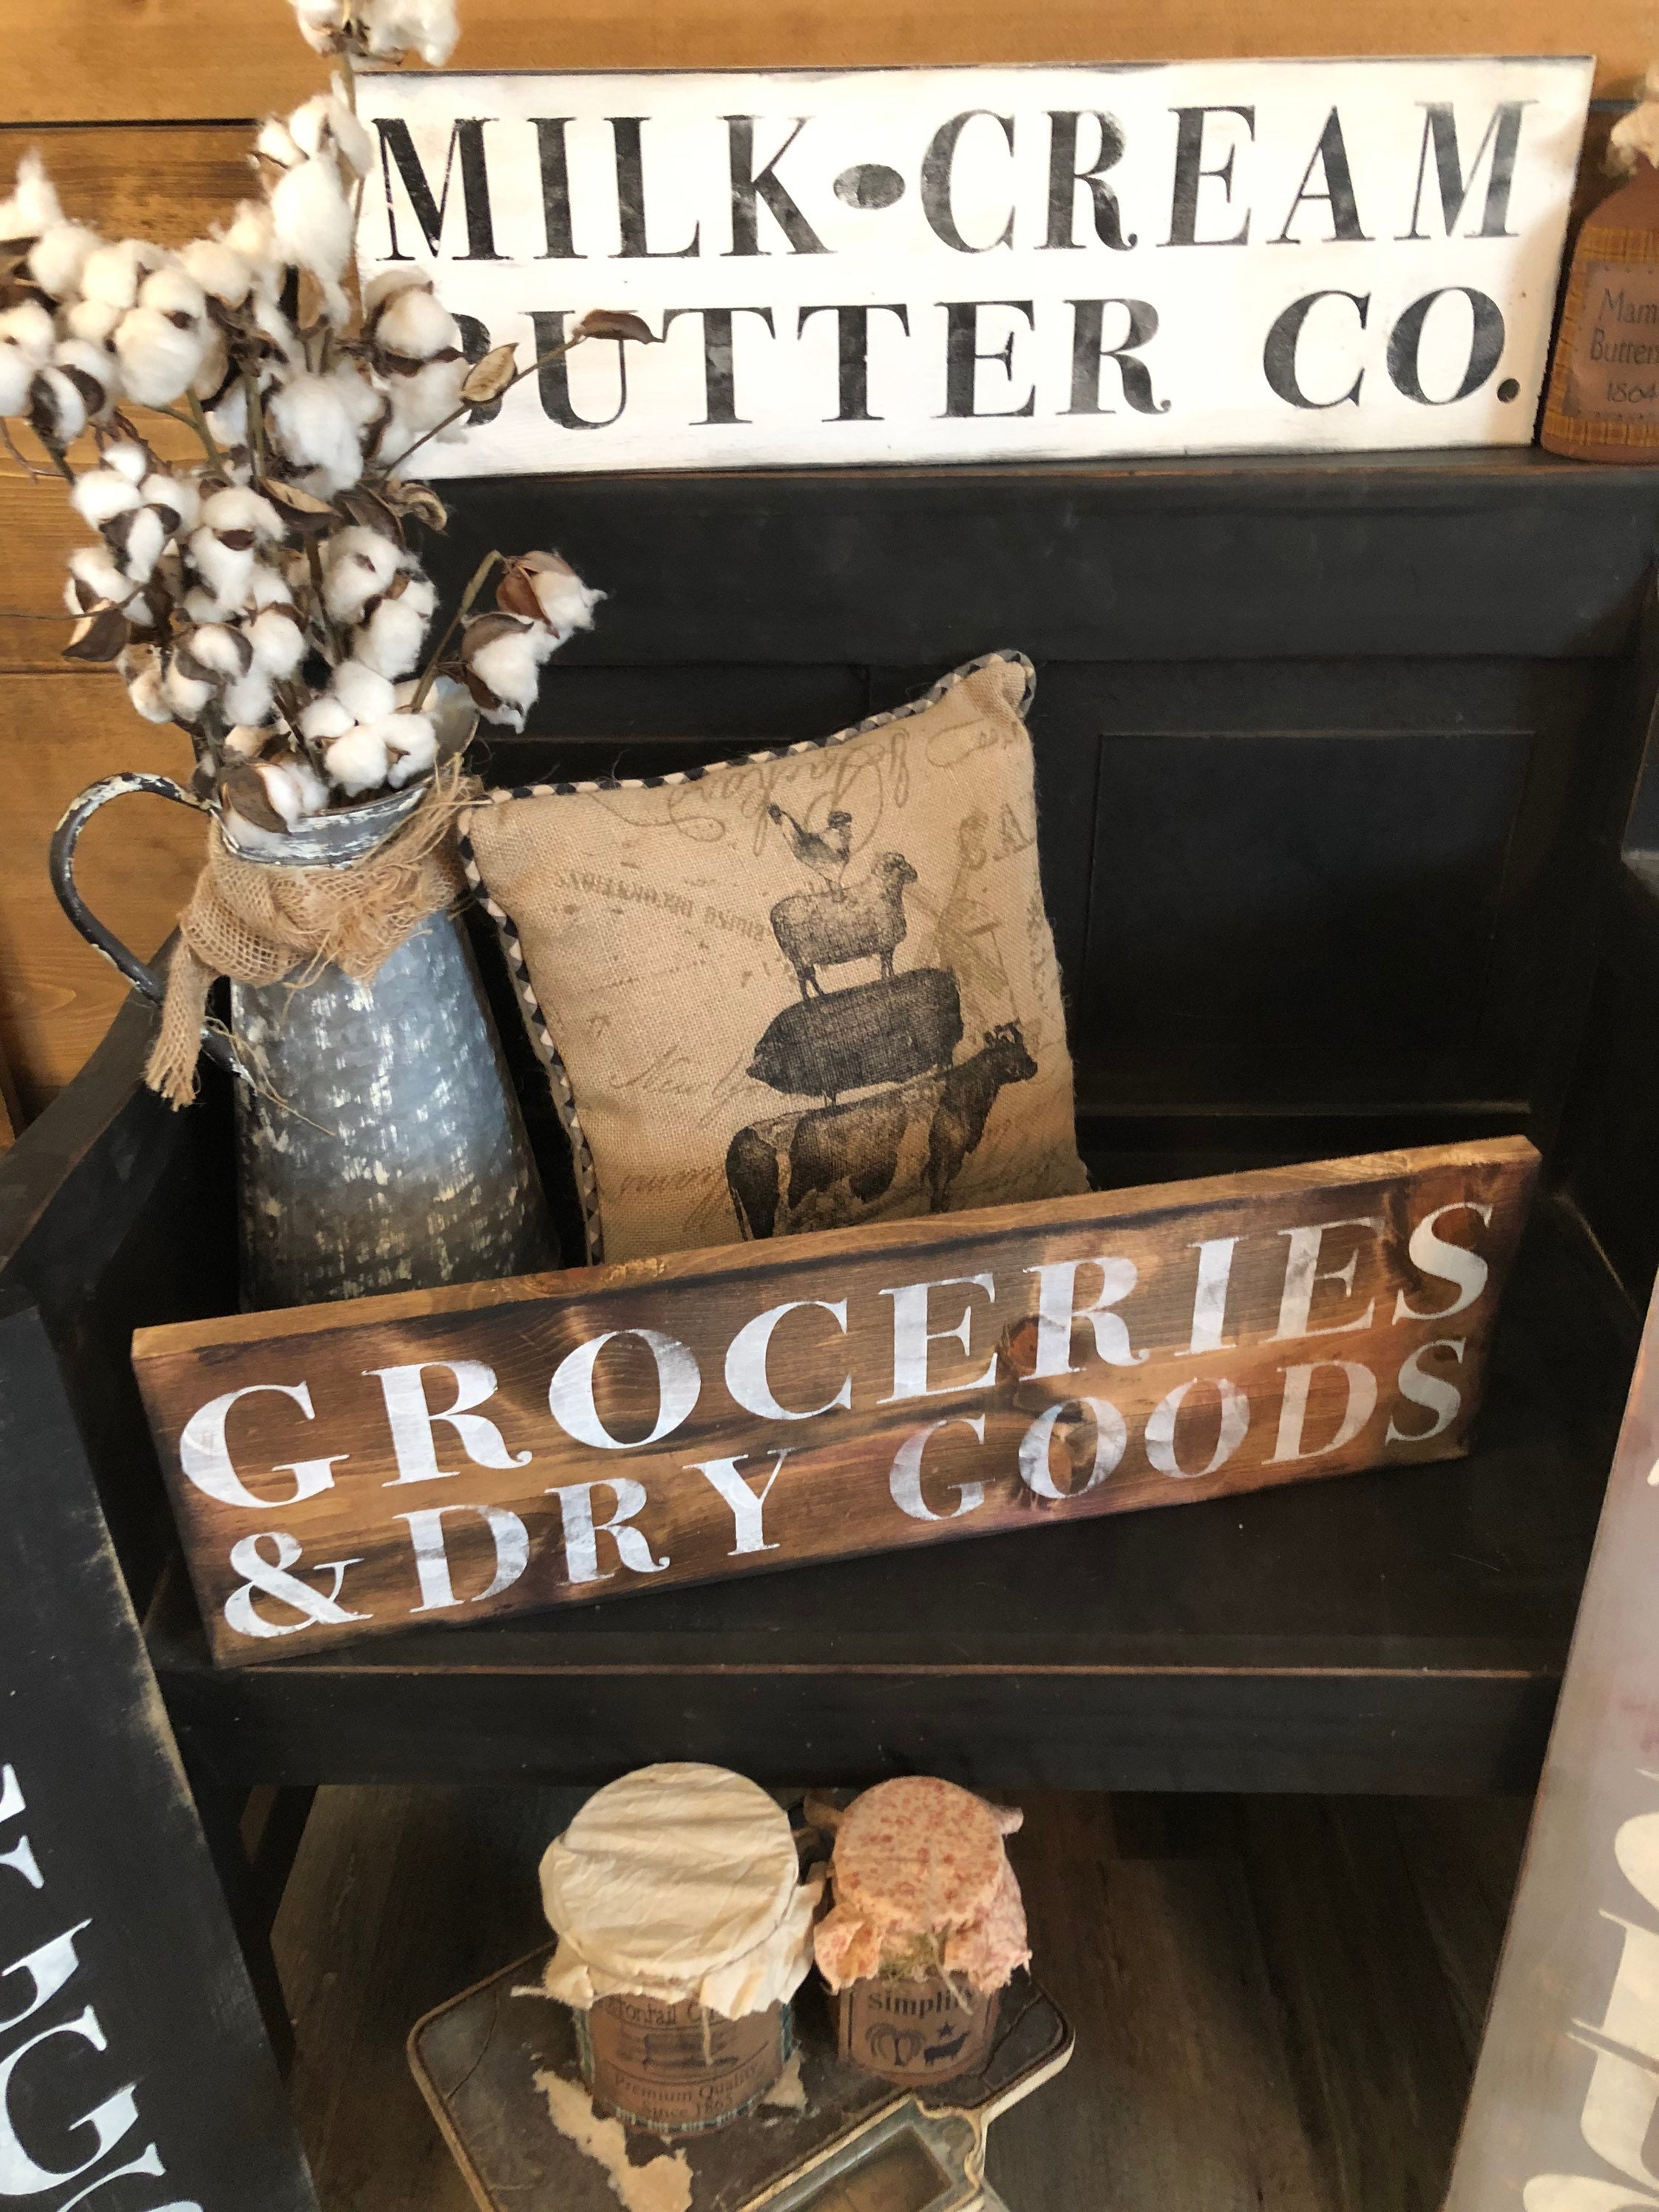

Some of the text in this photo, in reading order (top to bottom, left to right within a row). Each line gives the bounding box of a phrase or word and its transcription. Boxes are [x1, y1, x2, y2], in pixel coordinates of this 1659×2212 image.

[1263, 285, 1521, 410] CO.
[179, 1201, 1493, 1509] GROCERIES
[889, 1336, 1467, 1521] GOODS
